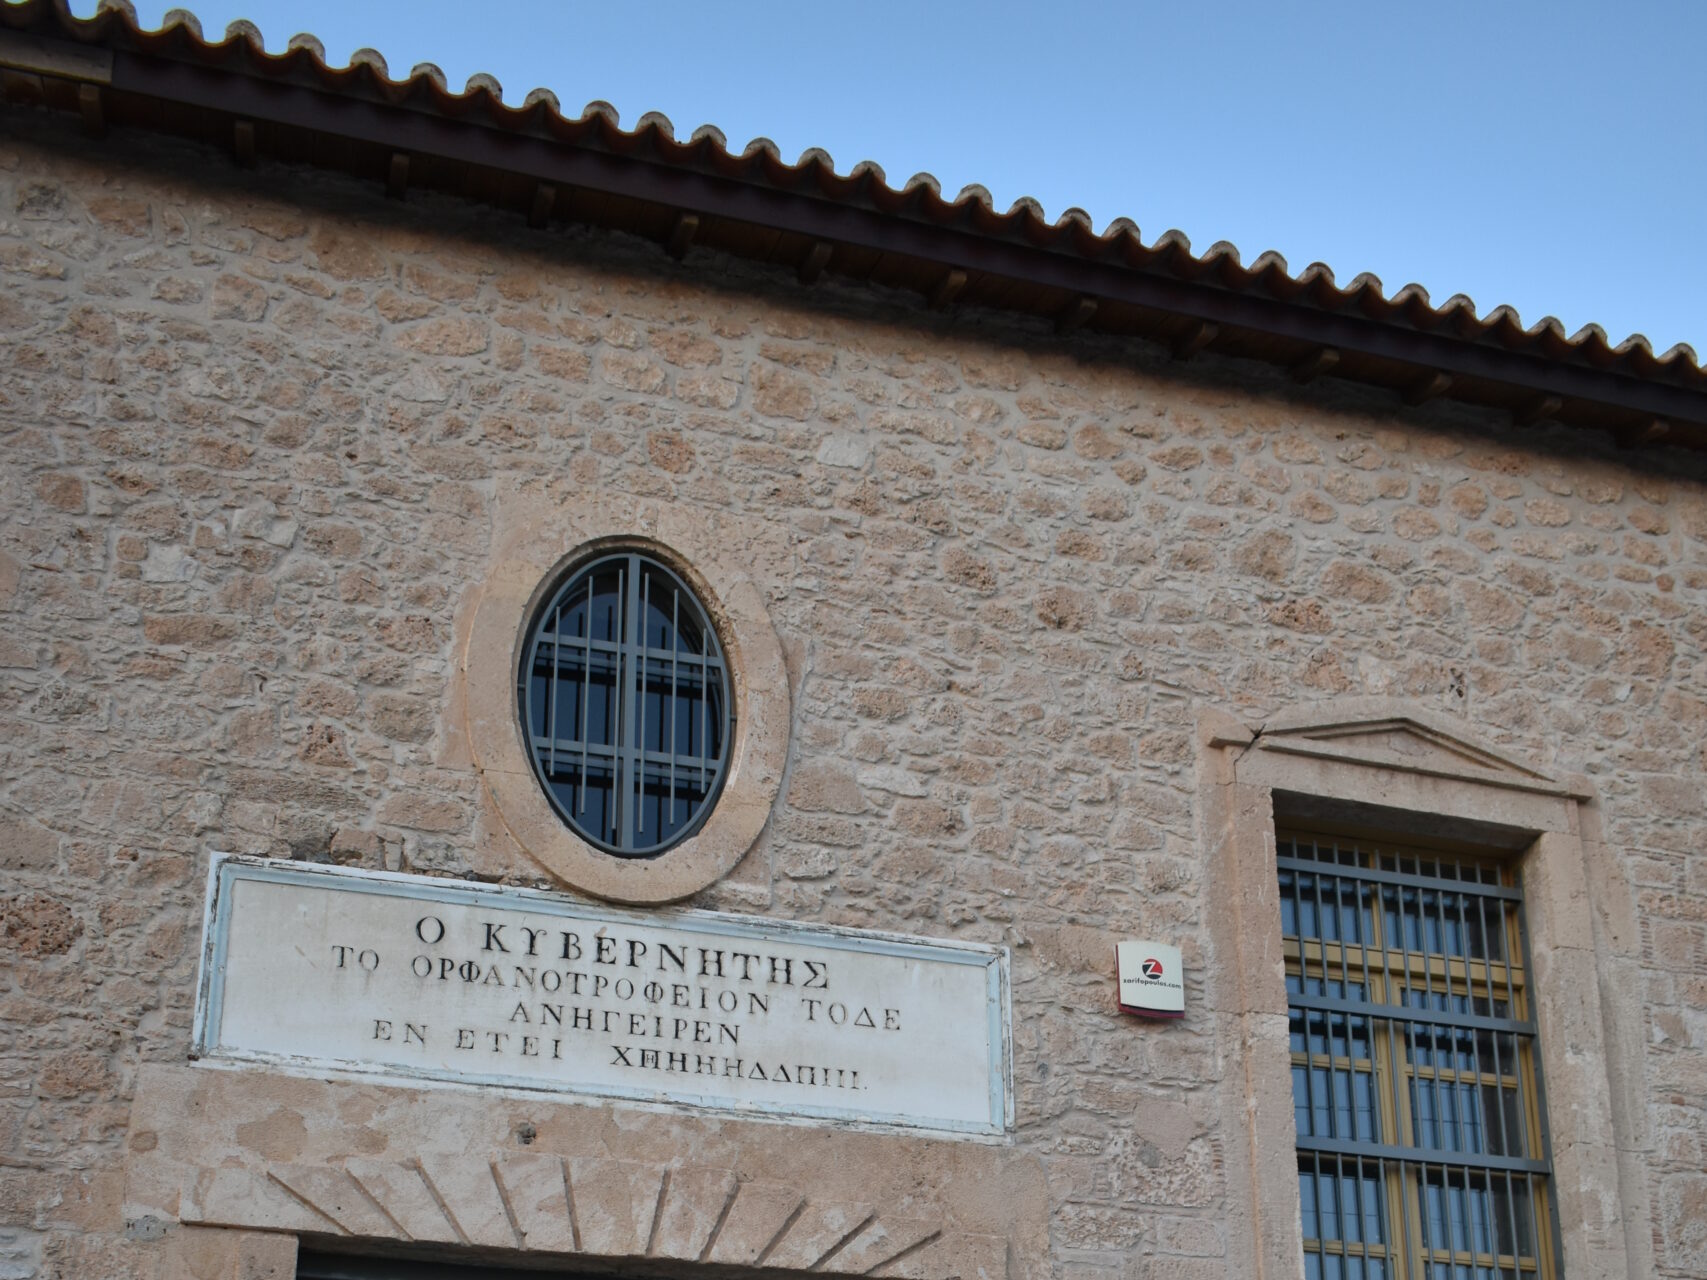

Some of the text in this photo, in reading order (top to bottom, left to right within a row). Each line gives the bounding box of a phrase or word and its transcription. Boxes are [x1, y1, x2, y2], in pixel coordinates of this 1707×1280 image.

[415, 915, 829, 989] Ο ΚΥΒΕΡΝΗΤΗΣ
[331, 945, 901, 1031] ΤΟ ΟΡΦΑΝΟΤΡΟΦΕΙΟΝ ΤΟΔΕ
[372, 1019, 429, 1045] ΕΝ
[455, 1028, 563, 1059] ΕΤΕΙ
[509, 1001, 741, 1046] ΑΝΗΓΕΙΡΕΝ
